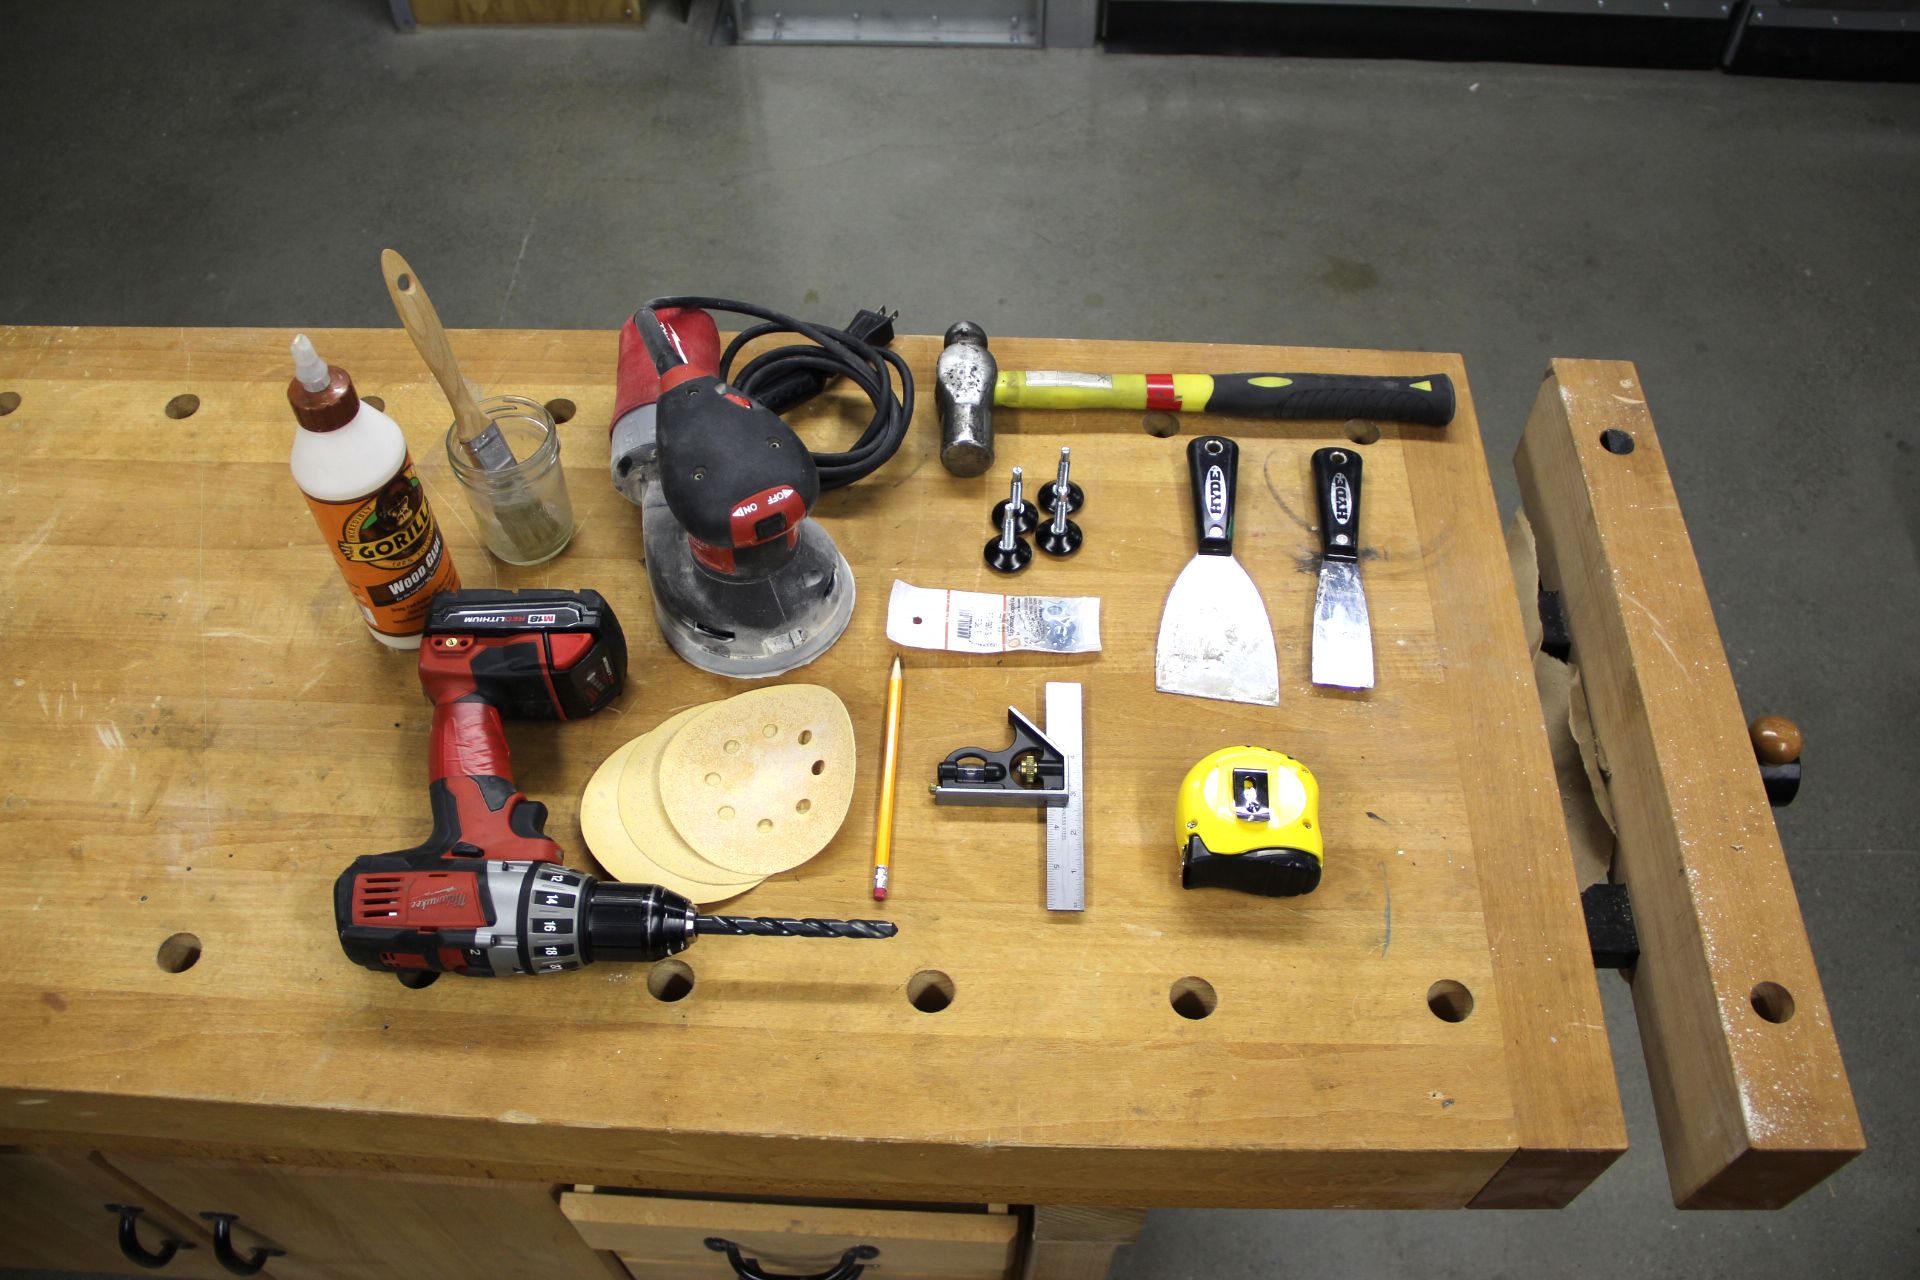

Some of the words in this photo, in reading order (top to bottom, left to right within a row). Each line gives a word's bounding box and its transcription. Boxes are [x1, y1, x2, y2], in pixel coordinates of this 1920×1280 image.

[767, 492, 786, 505] OFF
[1209, 470, 1222, 514] HYDE
[1335, 477, 1348, 520] HYDE
[744, 502, 758, 515] ON
[388, 564, 427, 596] WOOD
[529, 614, 555, 624] M18
[545, 894, 559, 906] 14
[543, 920, 557, 933] 16
[469, 948, 481, 956] 2
[544, 946, 558, 956] 18
